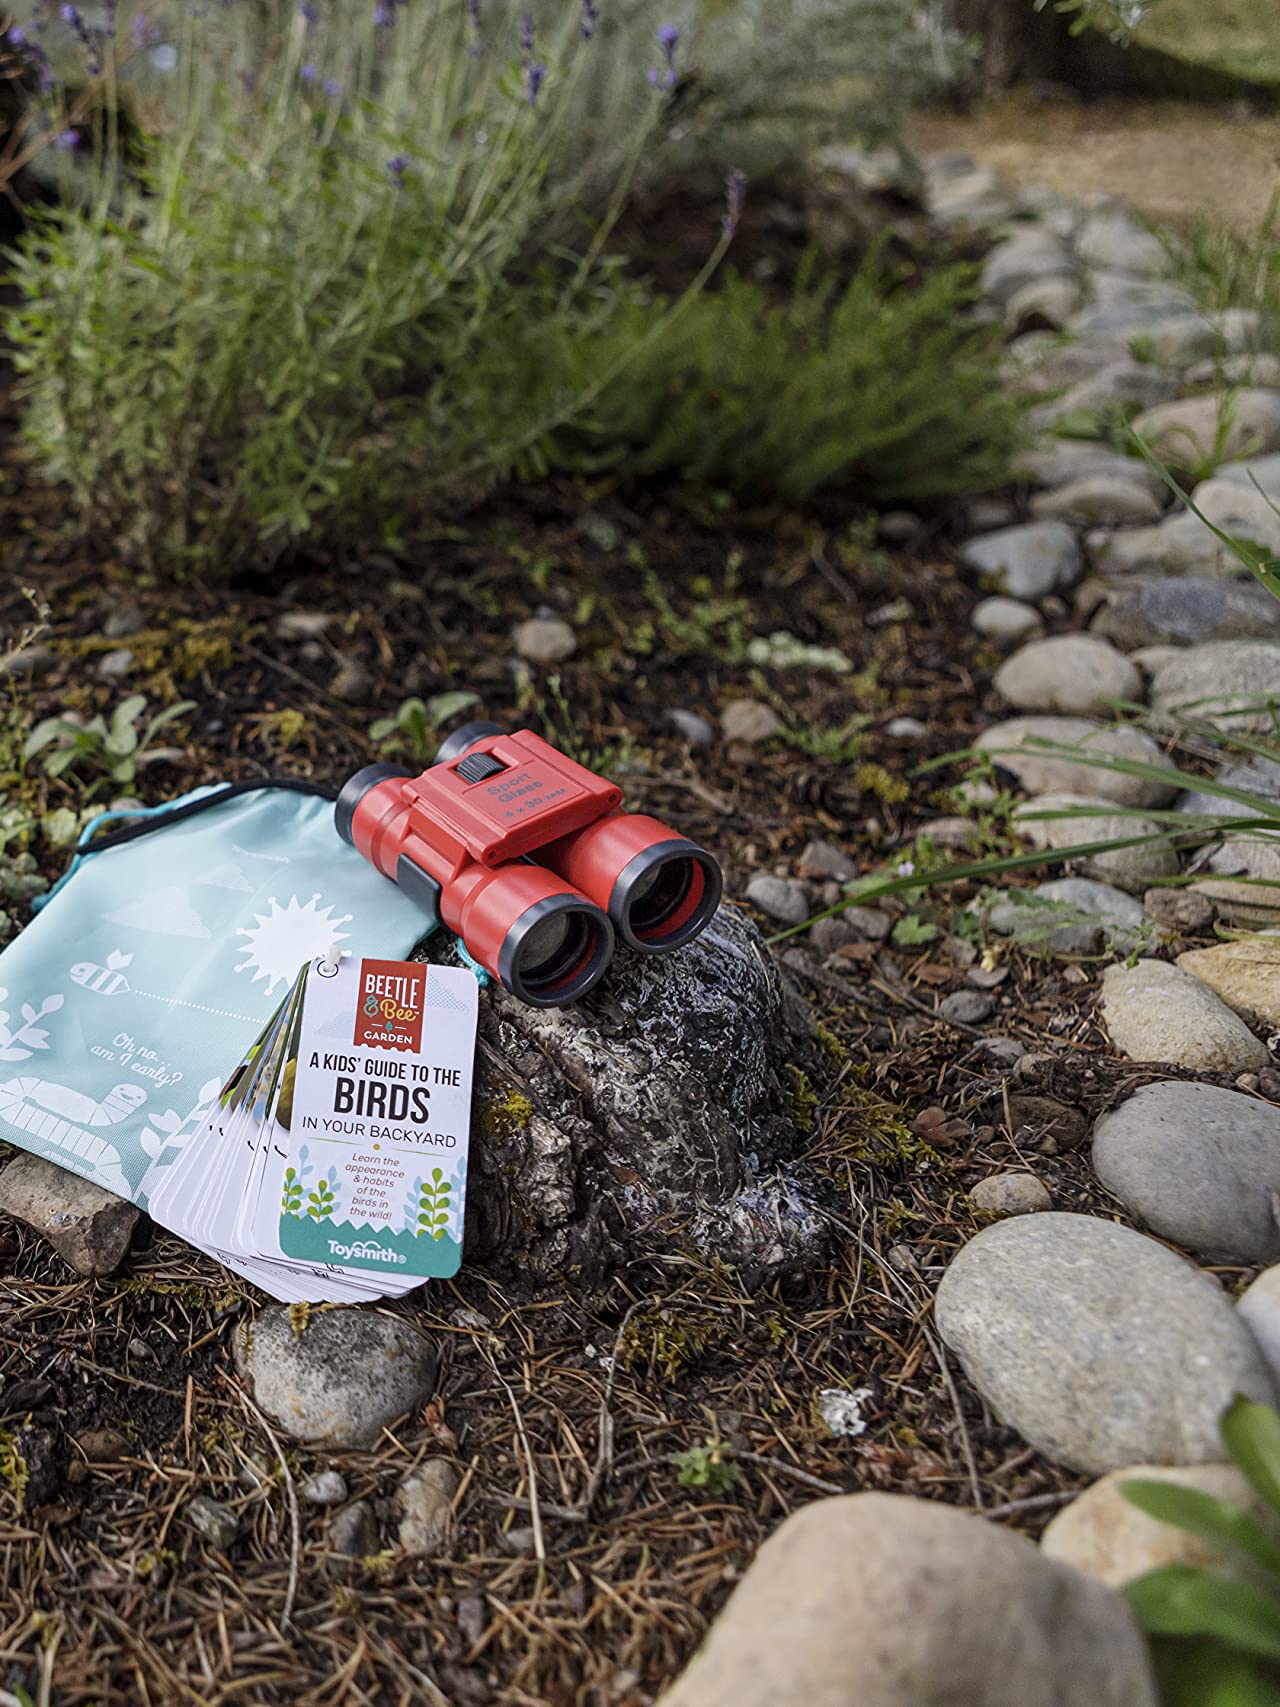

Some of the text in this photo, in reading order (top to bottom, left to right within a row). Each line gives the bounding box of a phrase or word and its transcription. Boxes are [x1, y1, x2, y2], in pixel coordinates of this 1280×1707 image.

[365, 974, 420, 1009] BEETLE
[363, 995, 379, 1017] &
[112, 1032, 136, 1052] Oh
[363, 1030, 413, 1045] GARDEN
[90, 1045, 115, 1061] am
[131, 1062, 183, 1088] early?
[309, 1052, 319, 1068] A
[364, 1059, 407, 1080] GUIDE
[411, 1065, 429, 1083] TO
[433, 1068, 462, 1087] THE
[333, 1076, 431, 1124] BIRDS
[302, 1116, 457, 1149] IN YOUR BACKYARD
[352, 1153, 400, 1167] Learn the
[345, 1164, 405, 1179] appearance
[353, 1174, 395, 1188] & habits
[356, 1186, 386, 1198] of the
[351, 1196, 389, 1209] birds in
[349, 1207, 393, 1221] the wild!
